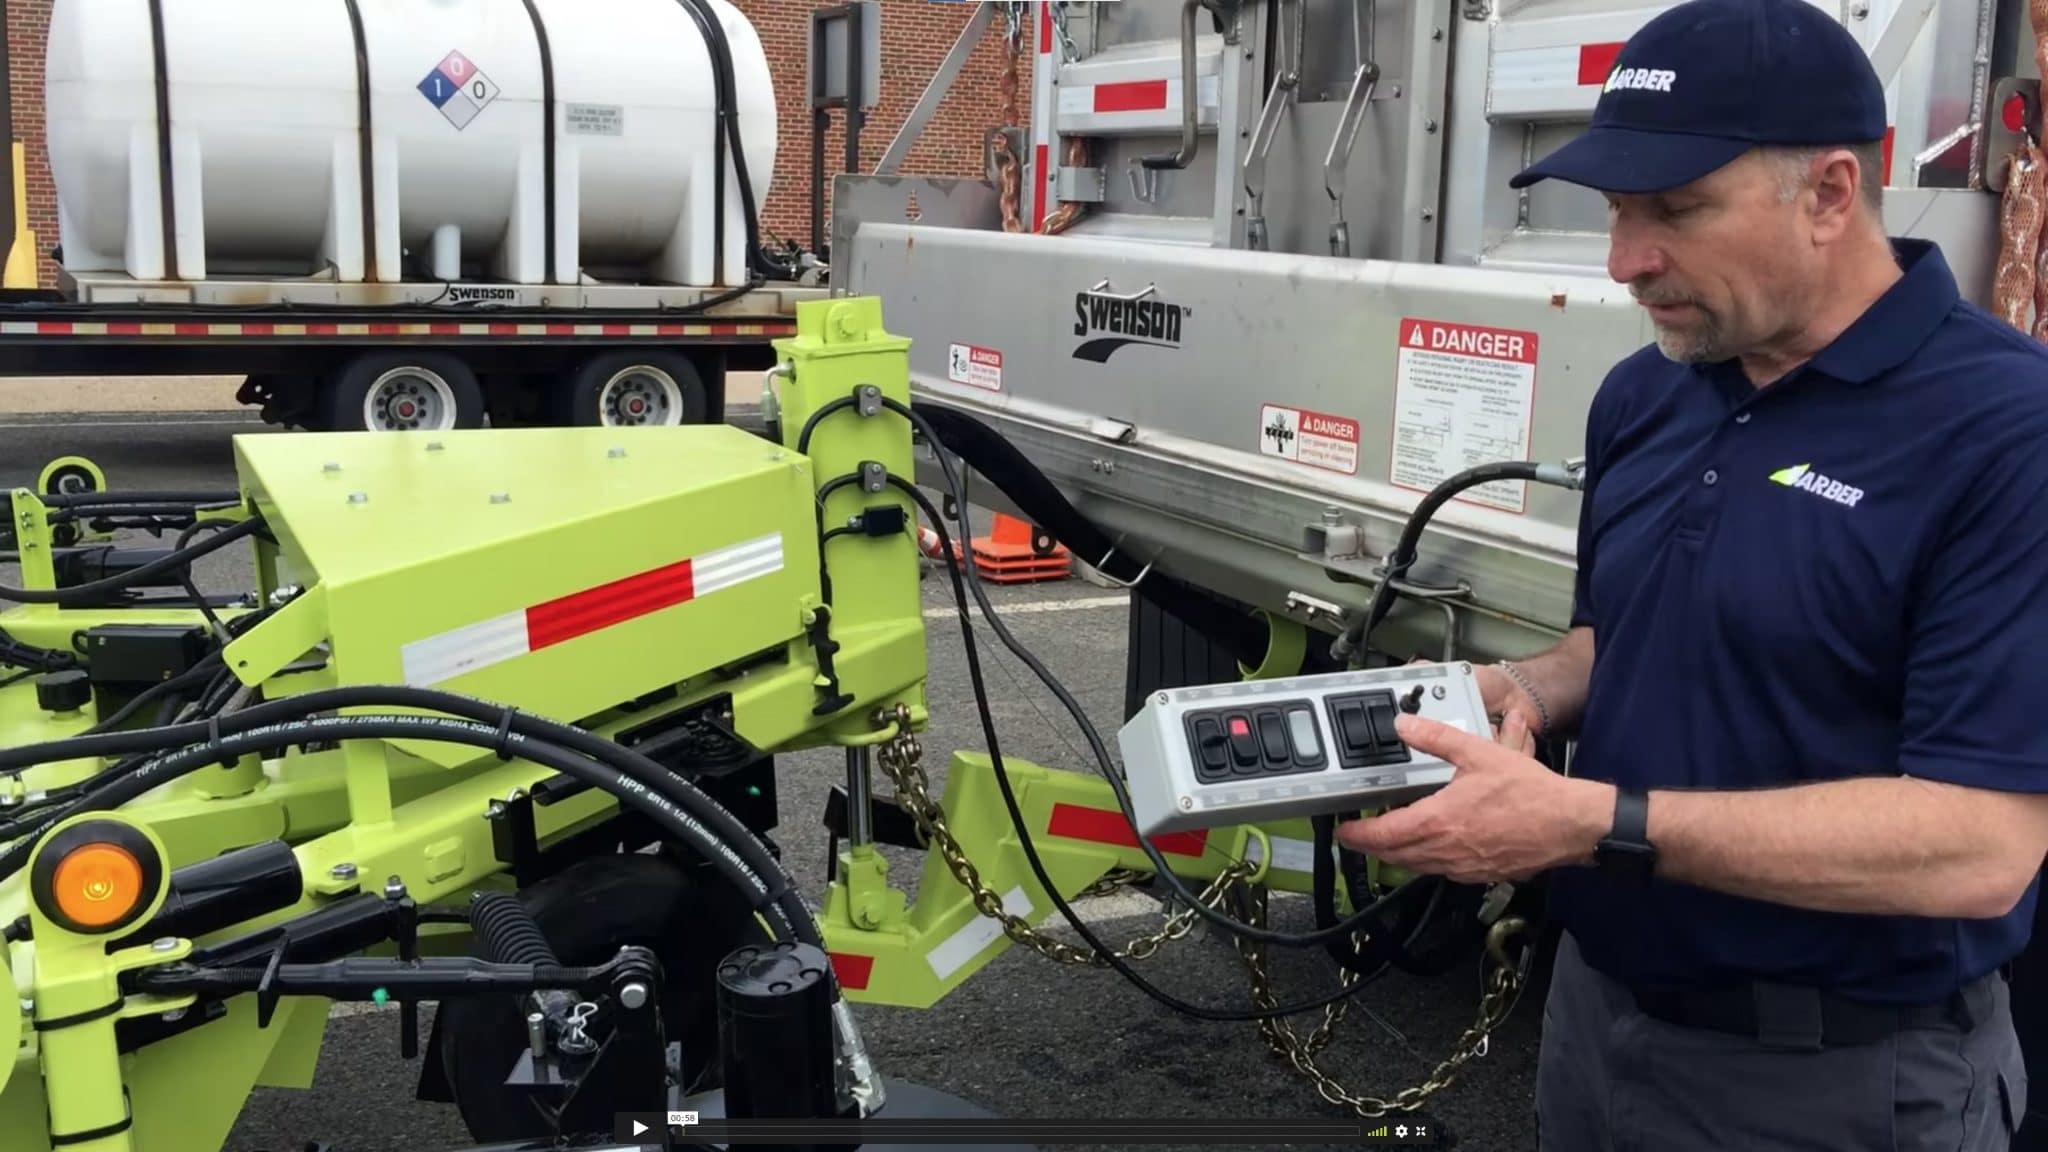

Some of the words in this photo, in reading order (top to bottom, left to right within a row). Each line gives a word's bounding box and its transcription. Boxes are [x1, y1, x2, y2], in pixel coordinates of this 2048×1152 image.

[449, 58, 464, 77] 0
[434, 78, 442, 98] 1
[473, 80, 486, 100] 0
[449, 287, 515, 301] Swenson
[1074, 292, 1181, 343] Swenson
[1431, 326, 1525, 359] DANGER
[1313, 418, 1356, 440] DANGER
[617, 773, 645, 793] HPP
